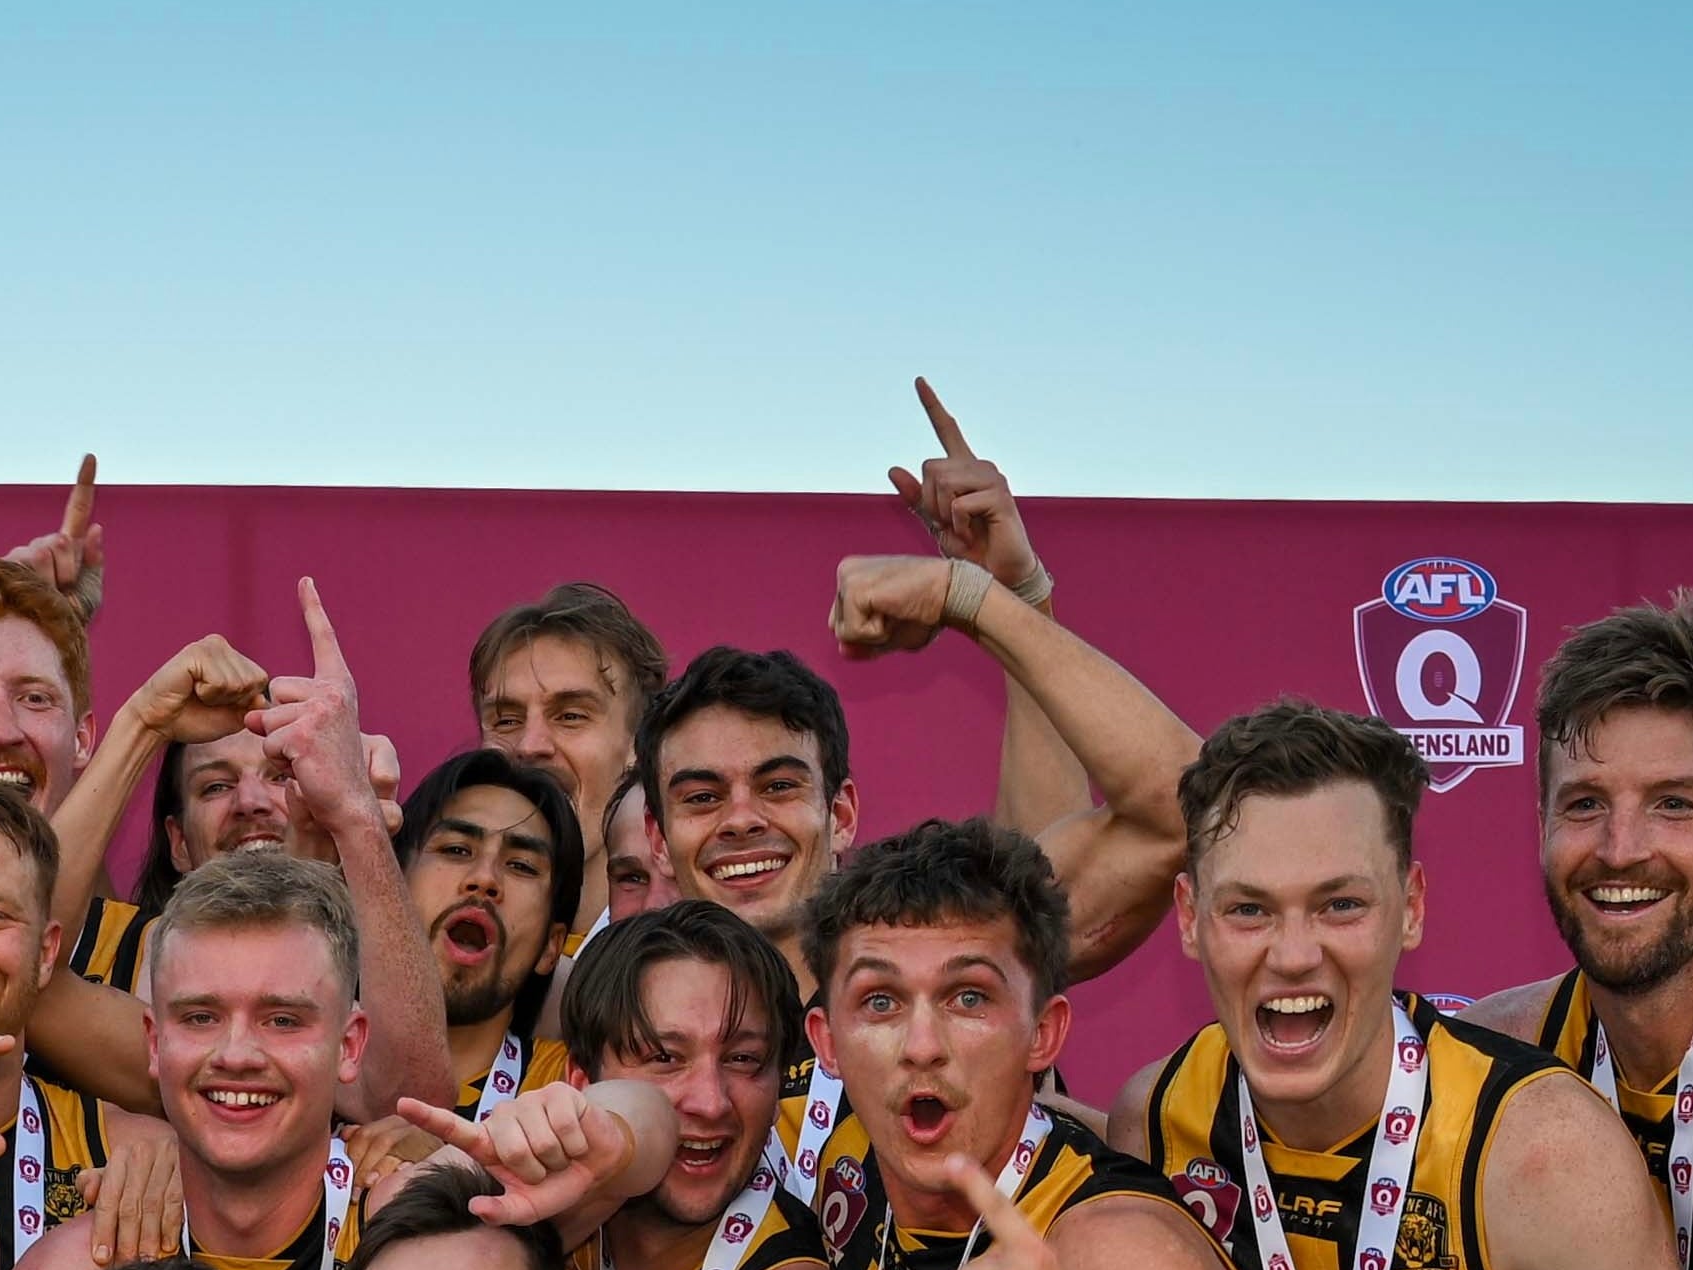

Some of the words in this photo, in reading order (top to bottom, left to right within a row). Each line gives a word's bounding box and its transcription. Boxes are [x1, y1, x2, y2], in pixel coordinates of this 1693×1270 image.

[1394, 573, 1486, 604] AFL
[1396, 629, 1484, 723] Q
[1411, 734, 1510, 756] ENSLAND
[836, 1160, 861, 1190] AFL
[1189, 1161, 1226, 1185] AFL
[1278, 1195, 1343, 1217] LRF
